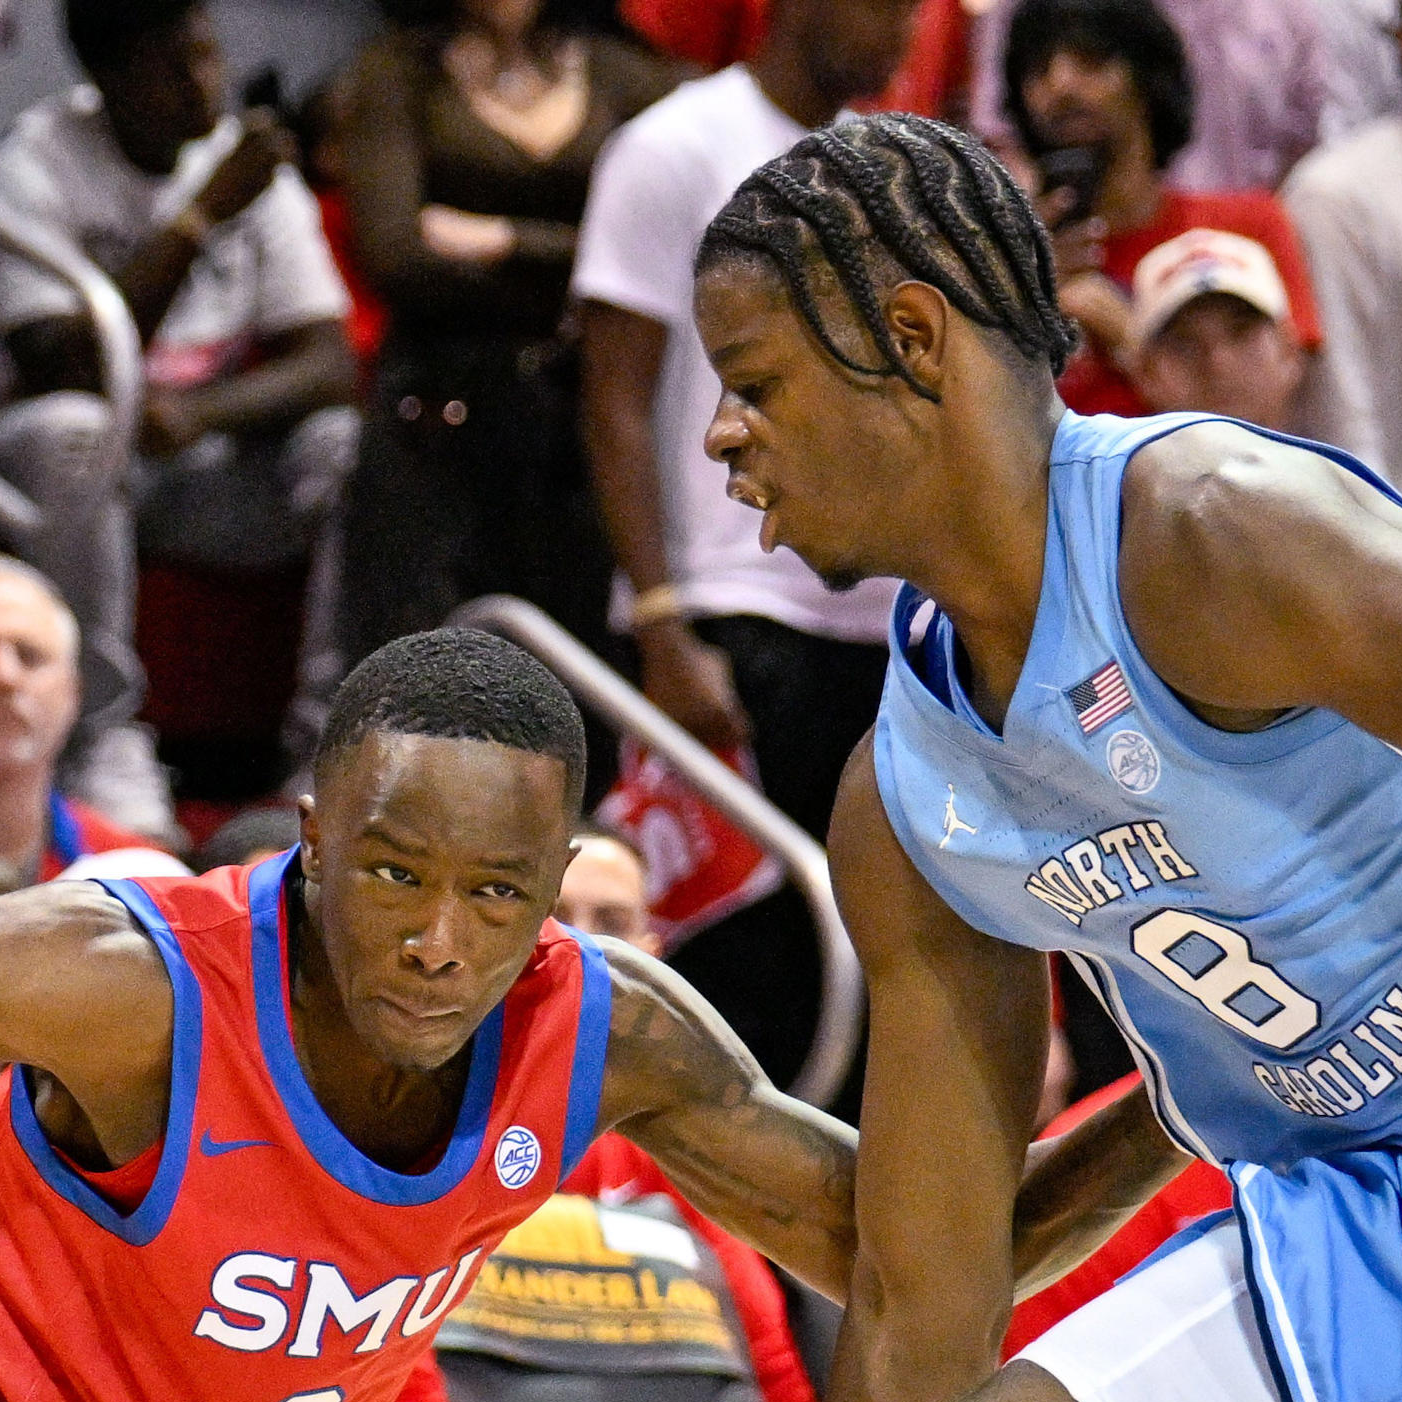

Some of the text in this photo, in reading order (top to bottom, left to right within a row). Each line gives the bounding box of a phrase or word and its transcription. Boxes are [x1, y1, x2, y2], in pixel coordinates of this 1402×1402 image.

[1024, 820, 1199, 926] NORTH
[1129, 907, 1322, 1051] 8
[500, 1143, 536, 1169] ACC
[193, 1245, 482, 1358] SMU
